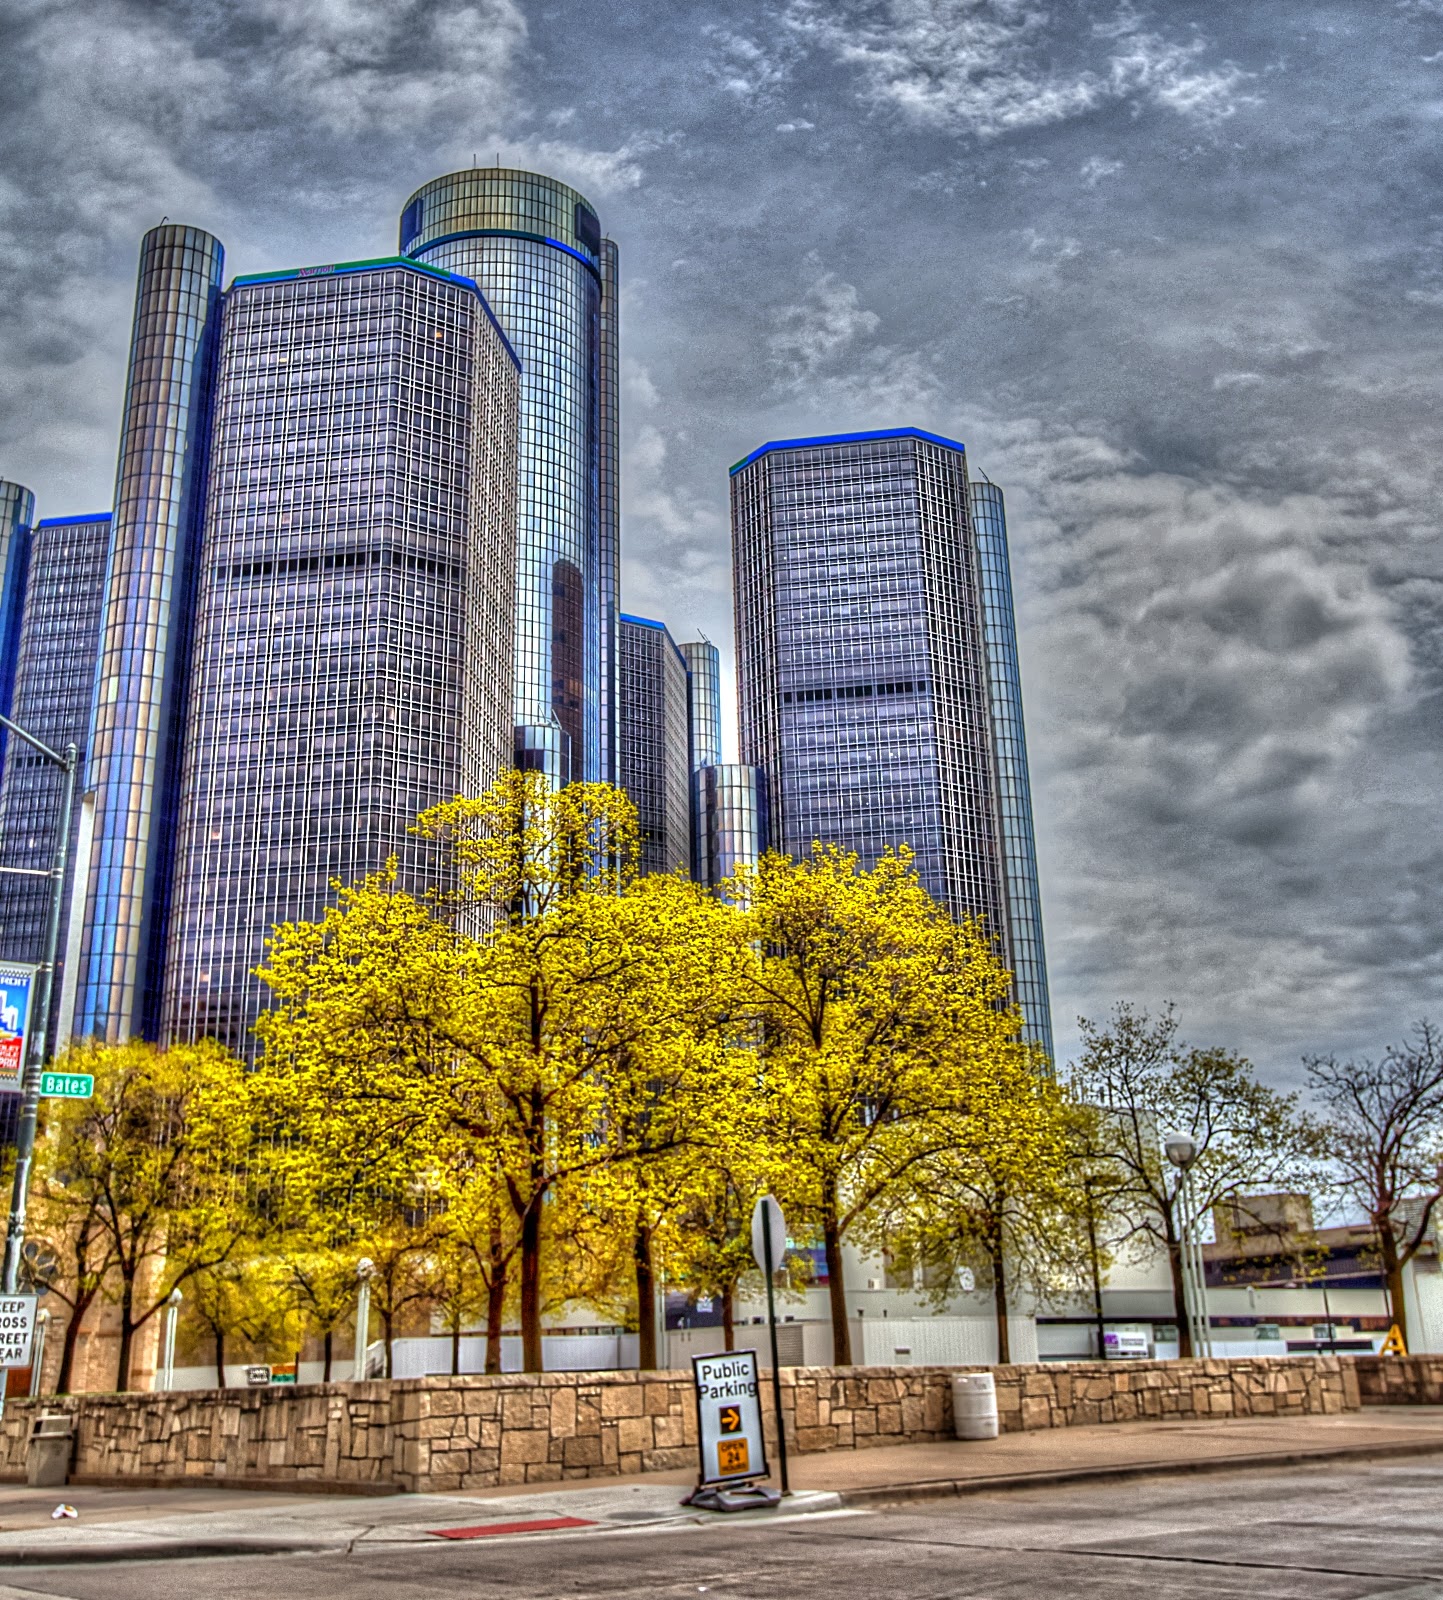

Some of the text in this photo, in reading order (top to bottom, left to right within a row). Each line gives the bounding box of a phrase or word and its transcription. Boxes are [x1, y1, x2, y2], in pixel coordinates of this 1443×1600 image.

[46, 1076, 87, 1094] Bates
[0, 1301, 25, 1313] EEP
[0, 1316, 27, 1329] OSS
[702, 1361, 750, 1381] Public
[699, 1381, 758, 1400] Parking
[721, 1442, 745, 1453] OPEN
[727, 1452, 741, 1465] 24
